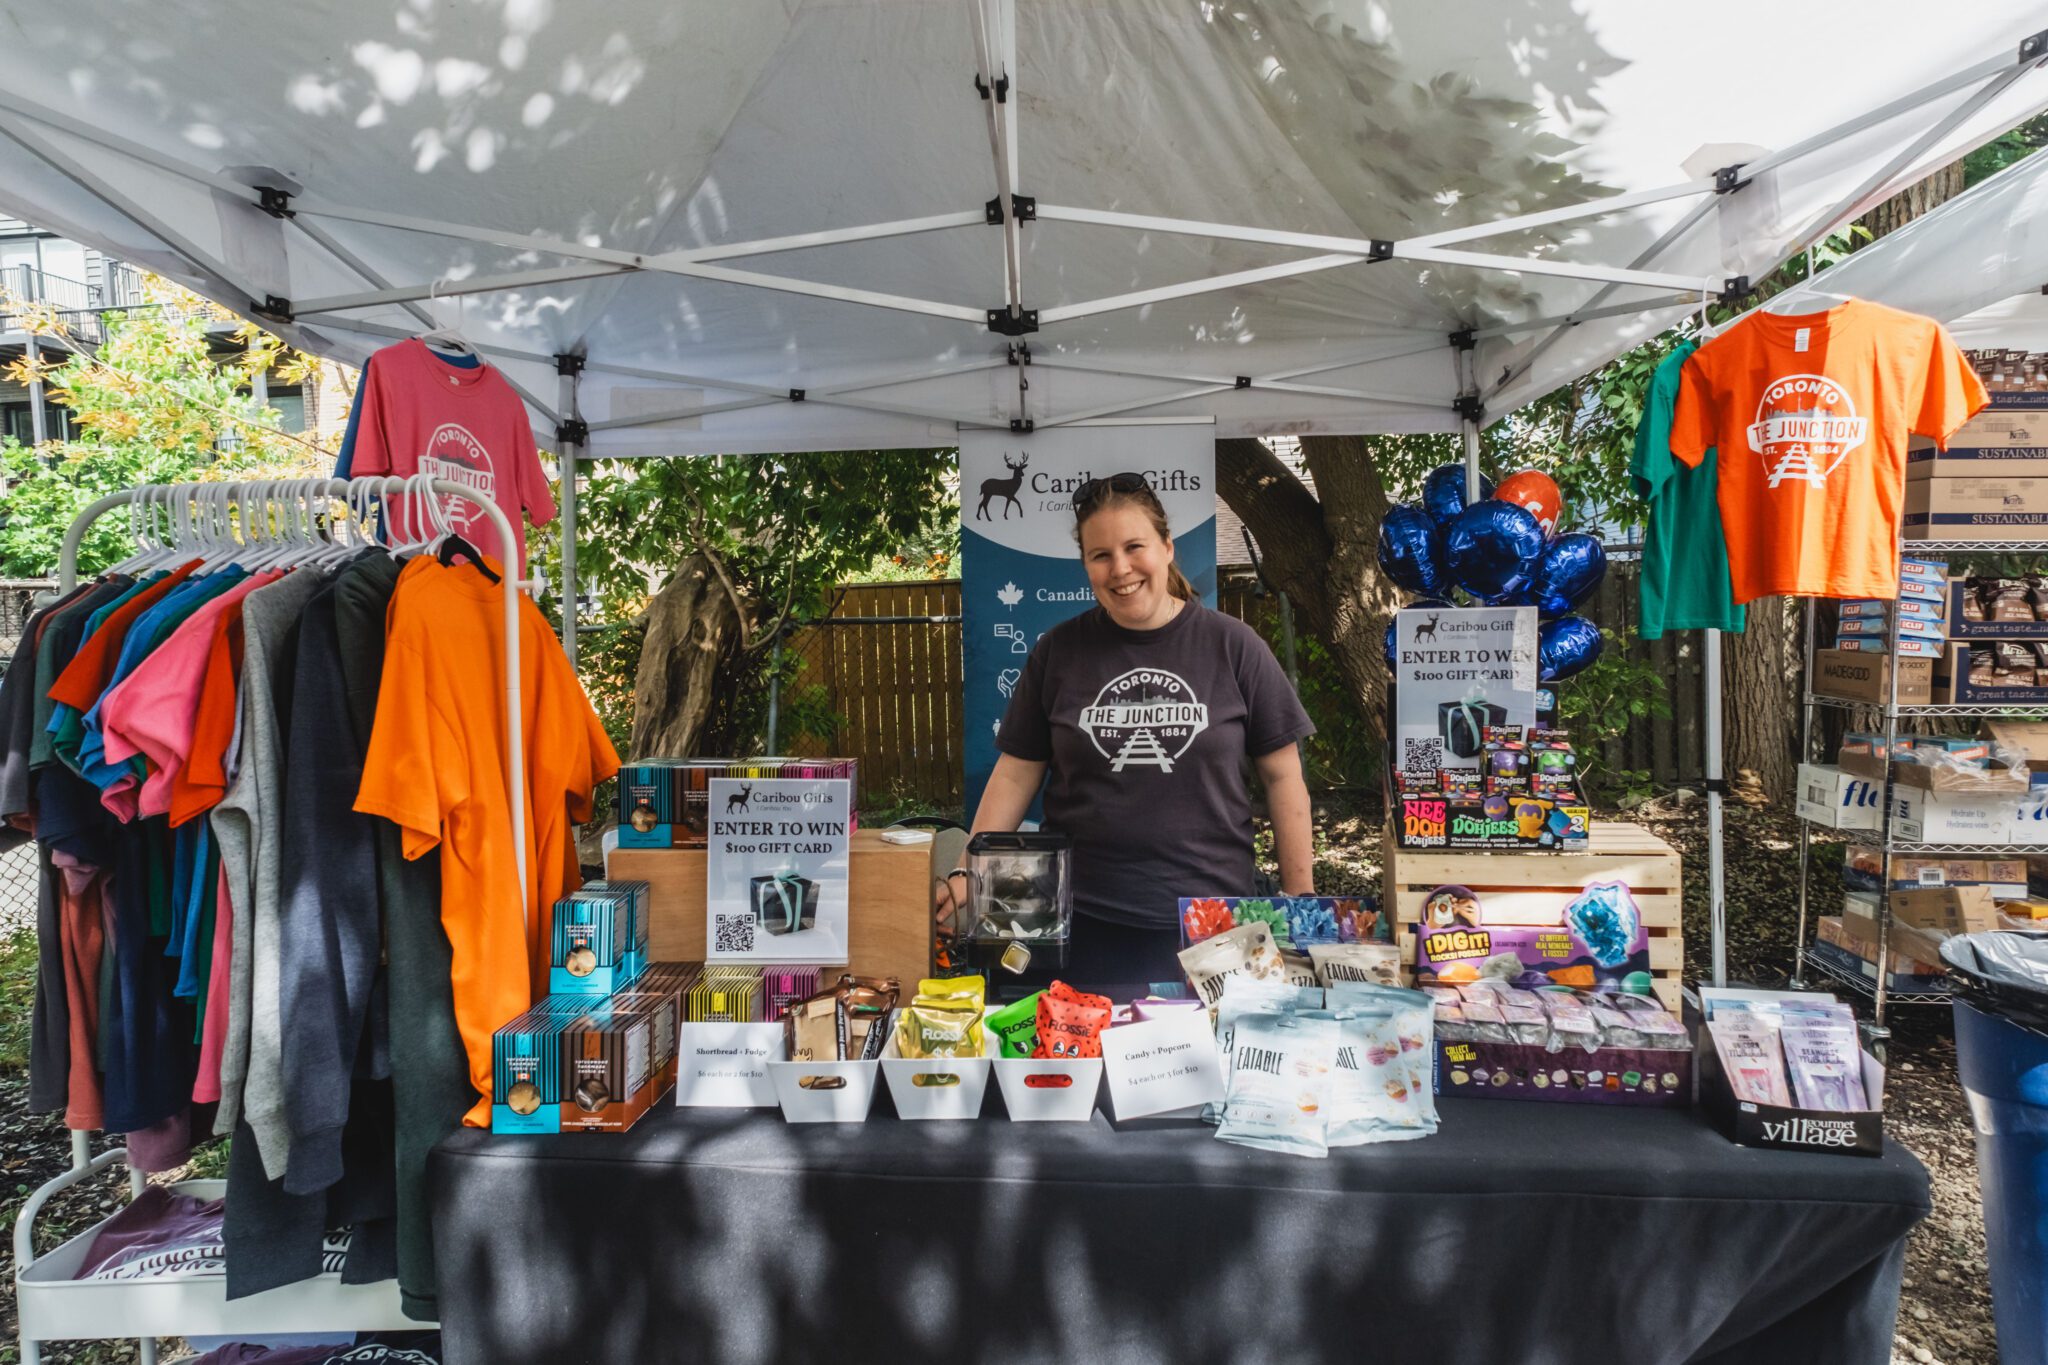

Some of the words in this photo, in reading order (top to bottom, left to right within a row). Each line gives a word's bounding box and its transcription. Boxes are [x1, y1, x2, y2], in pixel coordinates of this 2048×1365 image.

[1766, 380, 1839, 405] TORONTO
[1777, 421, 1860, 438] JUNCTION
[436, 429, 480, 458] TORONTO
[423, 459, 439, 476] TH
[1031, 471, 1091, 494] Cari
[1141, 469, 1201, 491] Gifts
[1046, 501, 1076, 511] Carib
[1906, 565, 1923, 573] CLIF
[1036, 587, 1097, 601] Canadia
[1906, 584, 1923, 592] CLIF
[1847, 606, 1860, 614] CLIF
[1440, 621, 1487, 632] Caribou
[1490, 620, 1515, 631] Gift
[1906, 621, 1922, 629] CLIF
[1971, 625, 2000, 634] great
[1846, 642, 1859, 650] CLIF
[1903, 642, 1920, 650] CLIF
[1402, 650, 1461, 663] ENTER
[1465, 649, 1490, 663] TO
[1414, 670, 1443, 681] $100
[1446, 670, 1478, 680] GIFT
[1824, 663, 1870, 680] MADEGOOD
[1110, 672, 1181, 695] TORONTO
[1086, 708, 1115, 723] THE
[1121, 706, 1203, 724] JUNCTION
[1100, 728, 1121, 738] EST.
[1160, 727, 1187, 737] 1884
[753, 792, 800, 802] Caribou
[804, 792, 833, 803] Gifts
[1403, 800, 1447, 824] NEE
[714, 822, 773, 835] ENTER
[778, 822, 803, 835] TO
[807, 822, 844, 836] WIN
[1404, 815, 1447, 836] DOH
[1569, 815, 1584, 833] 2
[726, 842, 756, 854] $100
[759, 842, 791, 853] GIFT
[794, 842, 832, 853] CARD
[1426, 940, 1433, 954] I
[1432, 931, 1468, 953] DIG
[1469, 933, 1489, 949] IT!
[1325, 962, 1368, 982] EATABLE
[744, 1048, 767, 1056] Fudge
[1125, 1050, 1150, 1060] Candy
[1157, 1043, 1191, 1055] Popcorn
[1445, 1044, 1469, 1055] COLLECT
[1237, 1046, 1283, 1076] EATABLE
[1449, 1054, 1465, 1062] THEM
[698, 1070, 706, 1078] $6
[751, 1070, 763, 1078] $10
[1139, 1073, 1156, 1083] each
[1172, 1068, 1183, 1076] for
[1185, 1066, 1199, 1074] $10
[1762, 1117, 1857, 1147] village
[1807, 1119, 1854, 1131] gourmet
